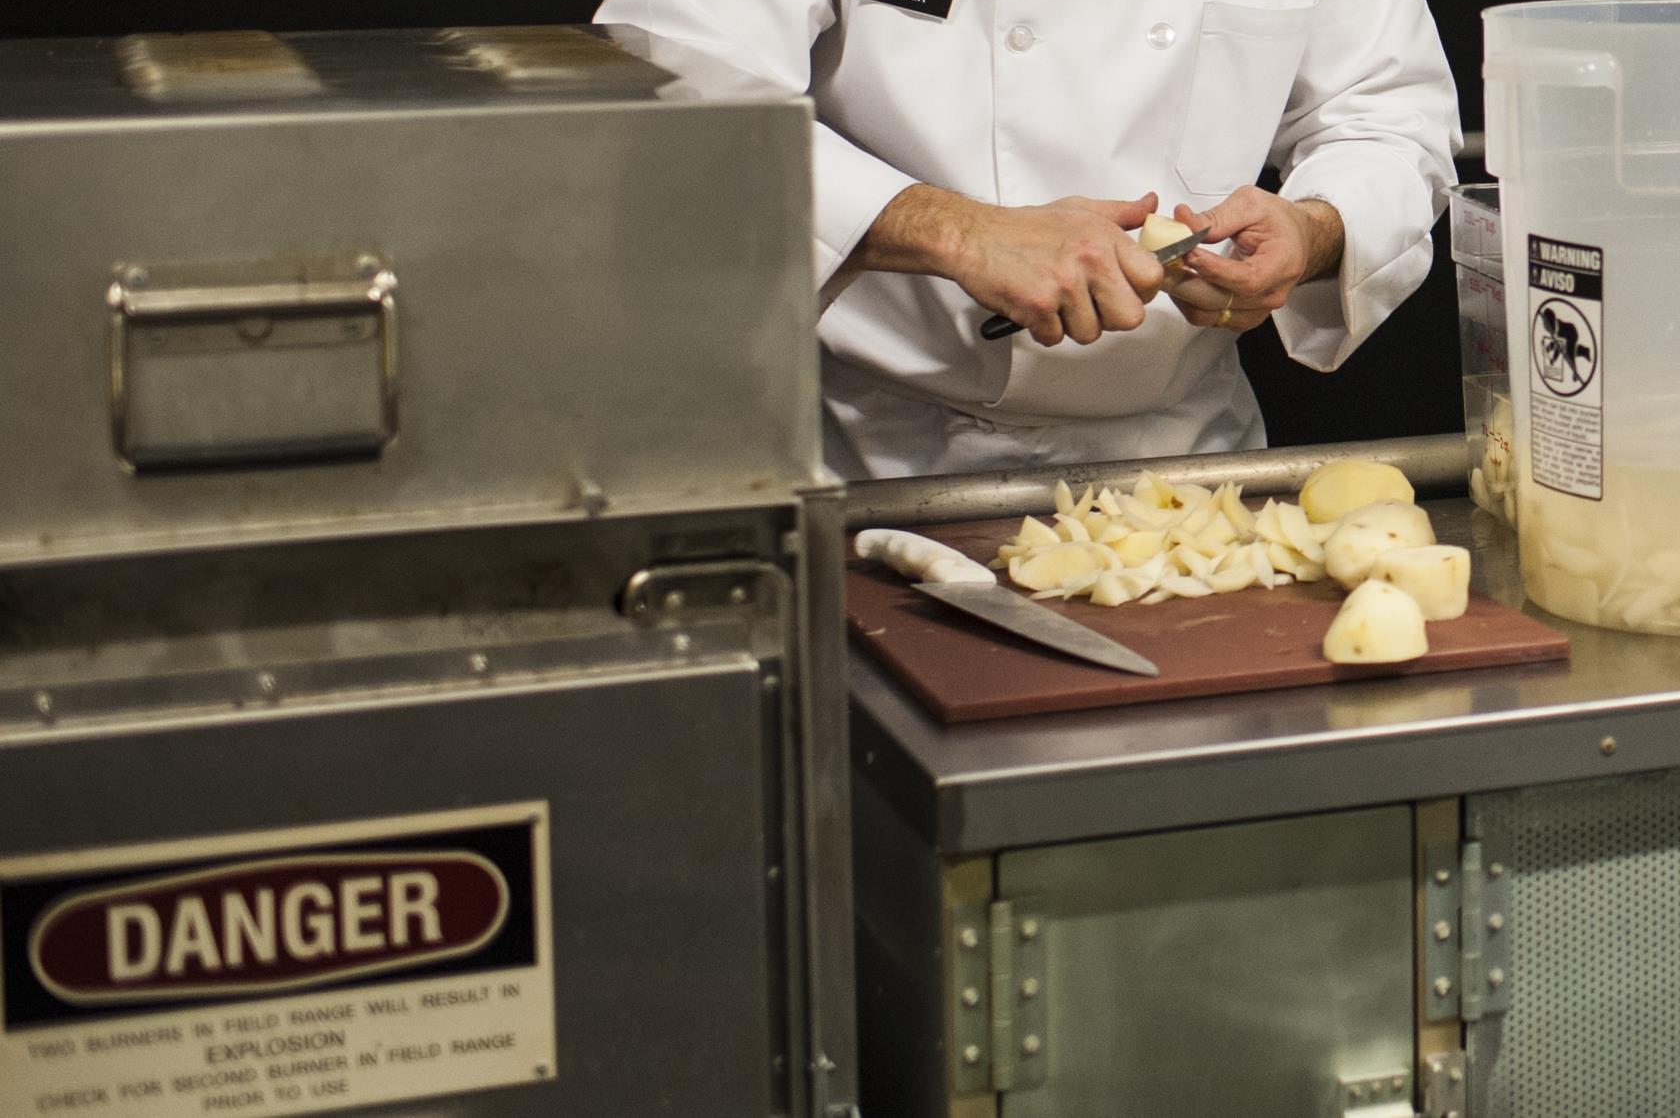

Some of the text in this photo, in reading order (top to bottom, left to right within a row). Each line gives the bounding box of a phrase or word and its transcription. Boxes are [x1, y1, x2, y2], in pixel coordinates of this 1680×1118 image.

[1540, 241, 1600, 270] WARNING
[1540, 268, 1575, 293] AVISO
[107, 871, 443, 982] DANGER
[85, 1026, 183, 1053] BURNERS
[223, 1014, 279, 1032] FIELD
[290, 1004, 356, 1025] RANGE
[366, 998, 409, 1016] WILL
[421, 986, 490, 1009] RESULT
[502, 983, 521, 998] IN
[174, 1067, 258, 1093] SECOND
[268, 1055, 349, 1079] BURNER
[358, 1051, 378, 1067] IN
[387, 1042, 441, 1063] FIELD
[452, 1032, 516, 1054] RANGE
[206, 1030, 346, 1065] EXPLOSION
[204, 1089, 265, 1111] PRIOR
[310, 1079, 349, 1097] USE
